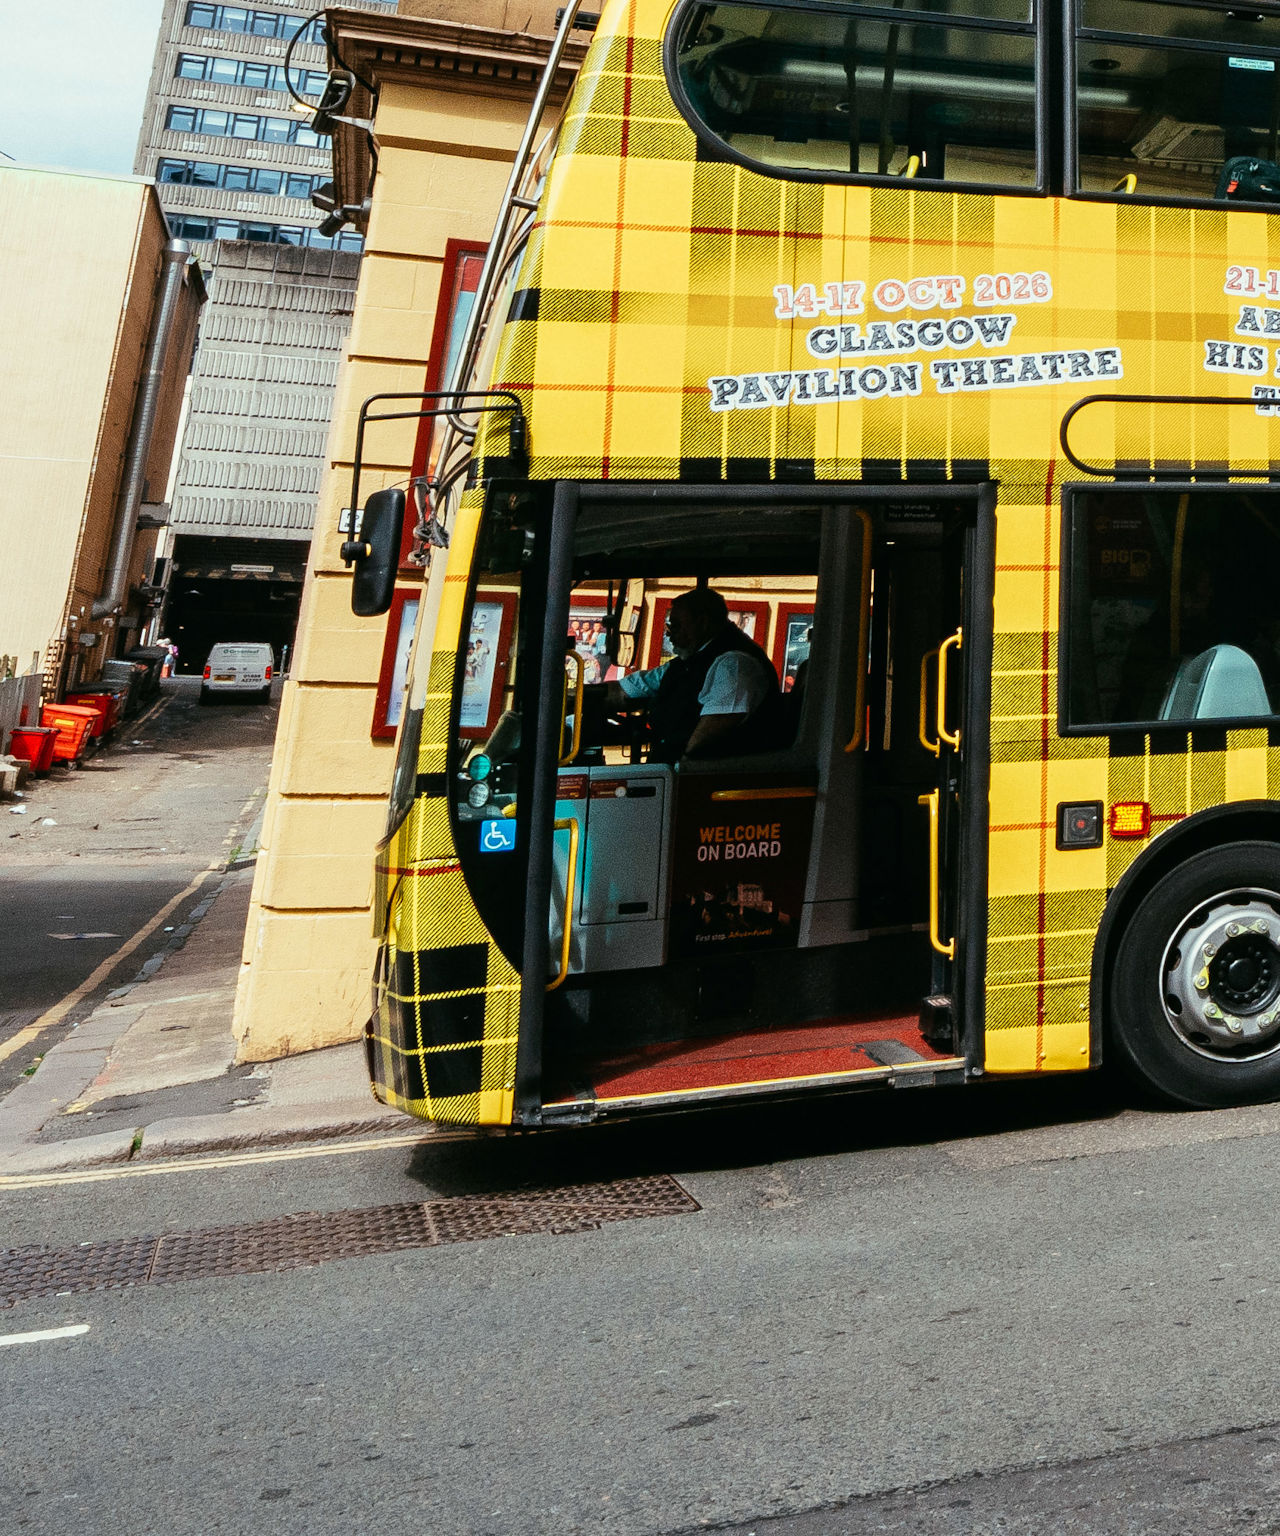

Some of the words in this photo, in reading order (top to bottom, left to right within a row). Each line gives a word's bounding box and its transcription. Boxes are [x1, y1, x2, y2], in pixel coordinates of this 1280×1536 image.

[776, 284, 860, 313] 14-17
[876, 278, 962, 308] OCT
[977, 273, 1049, 302] 2026
[809, 316, 1012, 354] GLASGOW
[1206, 342, 1264, 371] HIS
[711, 364, 921, 407] PAVILION
[934, 349, 1120, 394] THEATRE
[699, 823, 782, 843] WELCOME
[697, 845, 720, 861] ON
[724, 840, 782, 861] BOARD
